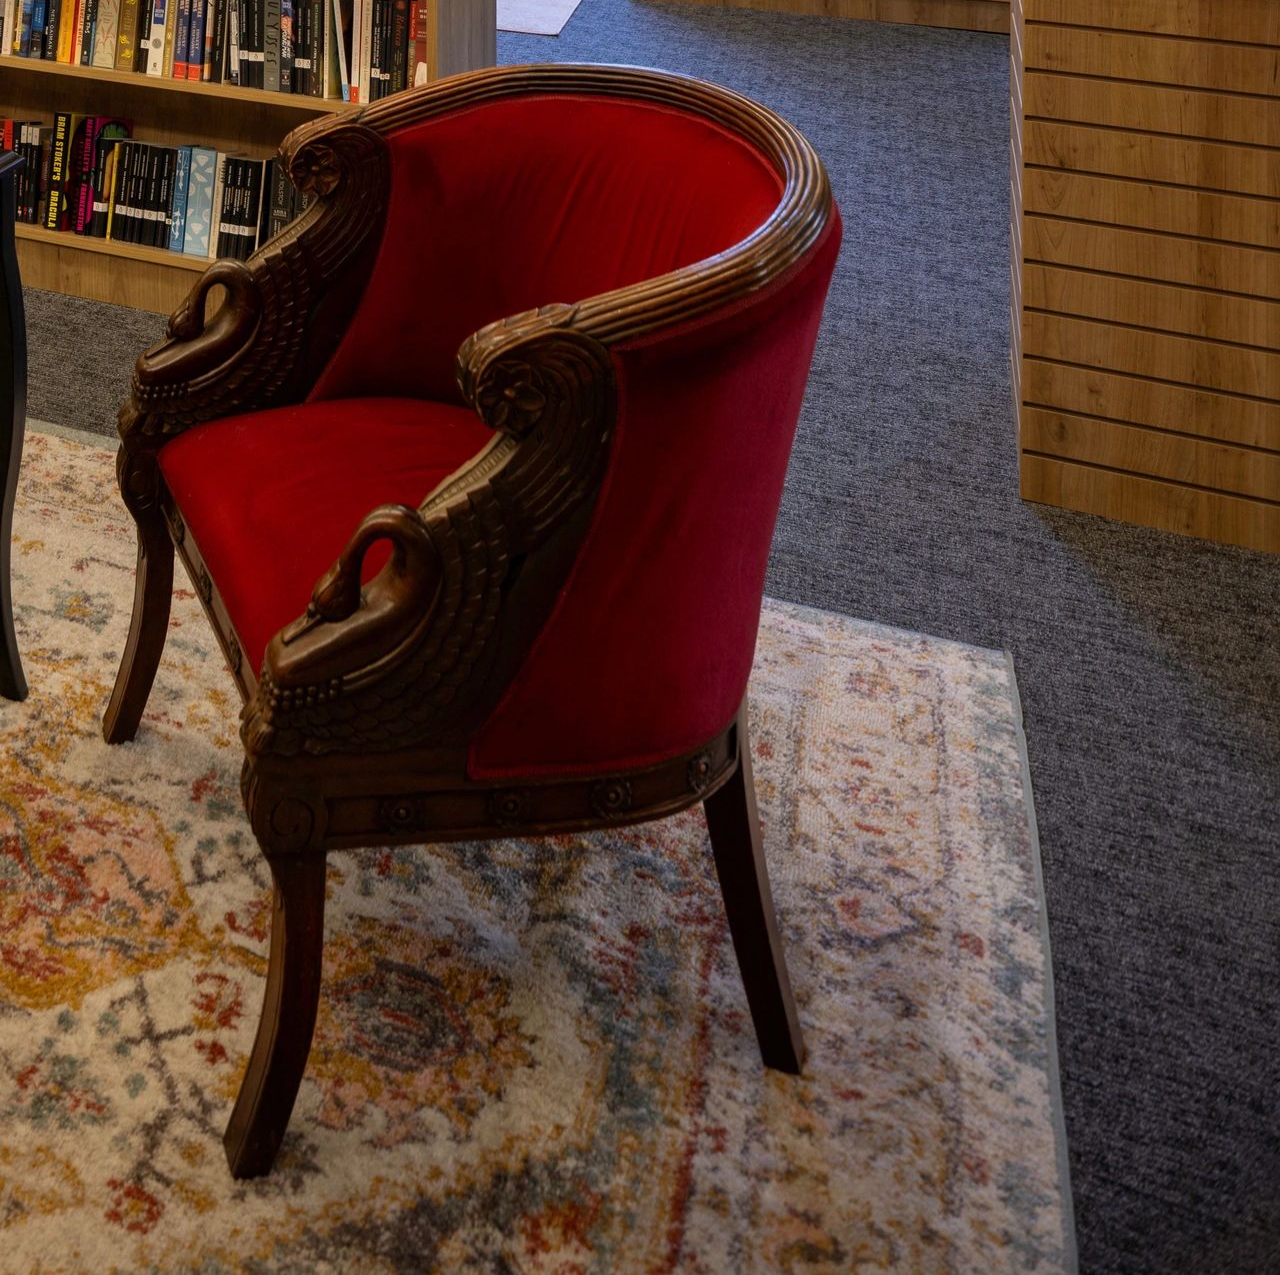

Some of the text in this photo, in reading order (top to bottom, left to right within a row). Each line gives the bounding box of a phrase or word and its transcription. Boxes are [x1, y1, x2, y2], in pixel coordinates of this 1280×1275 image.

[48, 116, 66, 227] BRAM STOKER'S DRACULA
